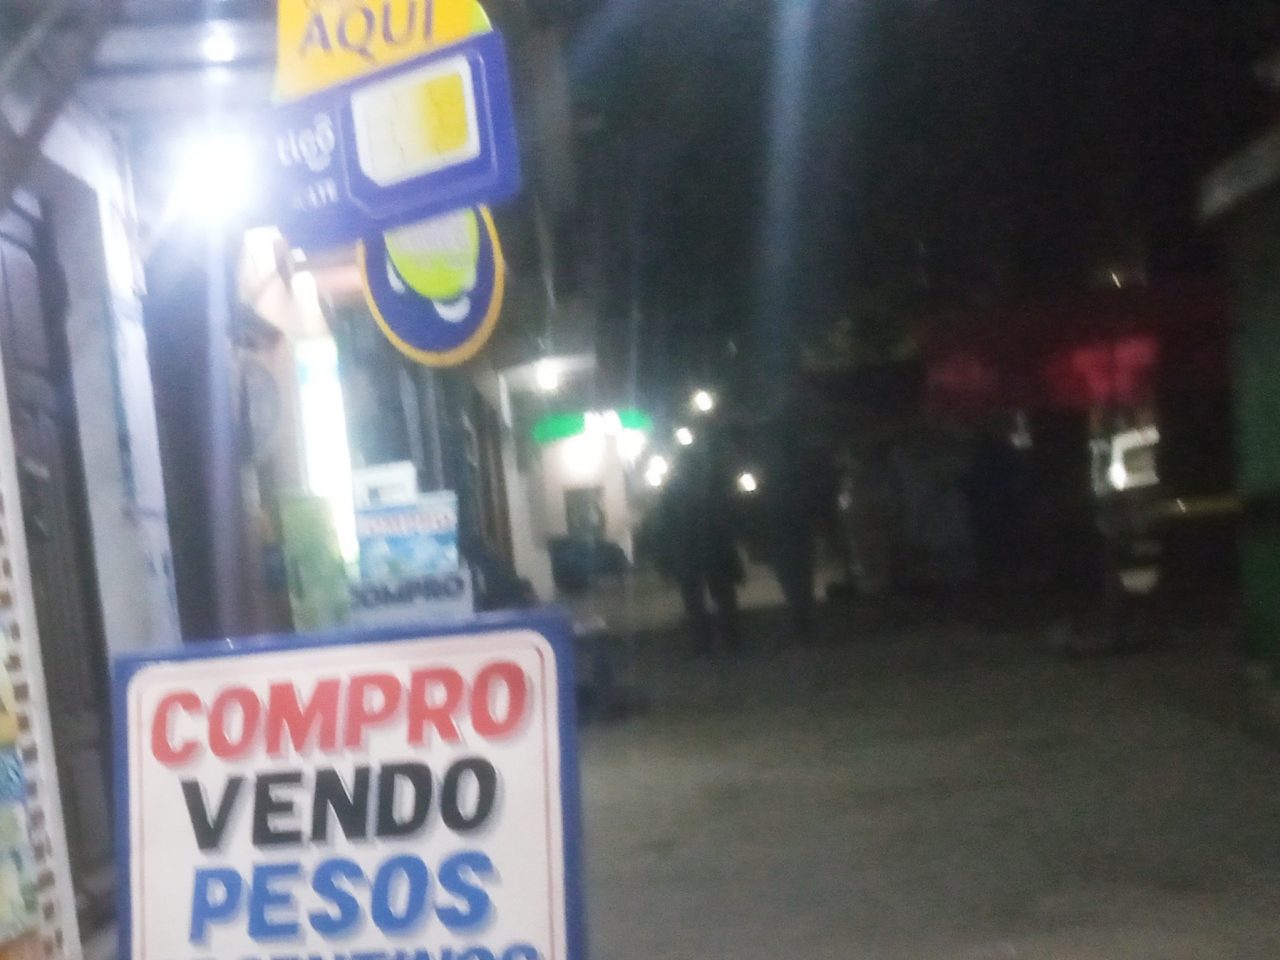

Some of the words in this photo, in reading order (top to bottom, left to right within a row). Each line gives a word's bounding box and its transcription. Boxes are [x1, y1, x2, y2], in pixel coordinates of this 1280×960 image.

[152, 661, 528, 767] COMPRO
[182, 757, 499, 850] VENDO
[190, 851, 494, 943] PESOS
